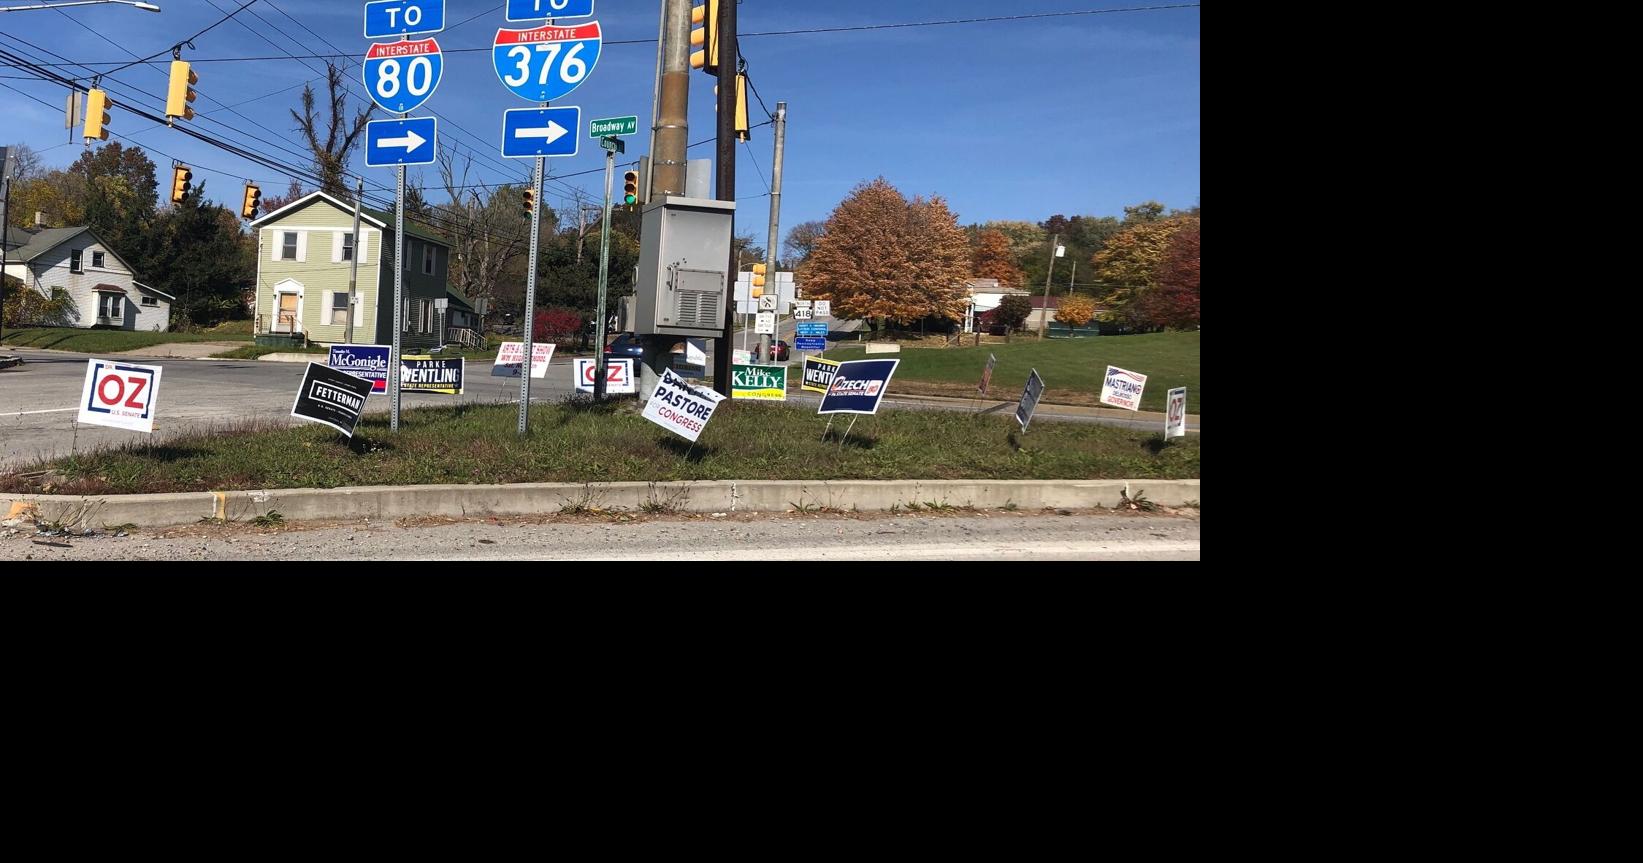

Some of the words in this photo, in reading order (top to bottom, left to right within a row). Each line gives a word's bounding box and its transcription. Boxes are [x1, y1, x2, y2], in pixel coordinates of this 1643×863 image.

[385, 5, 422, 28] TO
[518, 28, 577, 42] INTERSTATE
[376, 43, 430, 57] INTERSTATE
[504, 41, 587, 87] 376
[376, 57, 432, 98] 80
[591, 121, 625, 133] Broadway
[795, 310, 811, 318] 418
[331, 353, 387, 371] McGonigle
[416, 360, 446, 368] PARKE
[817, 363, 836, 373] PARK
[400, 368, 460, 383] WENTLING
[732, 371, 782, 388] KELLY
[745, 367, 772, 377] Mike
[806, 368, 833, 384] WENT
[98, 374, 147, 409] OZ
[1104, 377, 1142, 395] MASTRIANO
[316, 386, 361, 410] FETTERMAN
[654, 386, 713, 421] PASTORE
[658, 406, 703, 433] CONGRESS
